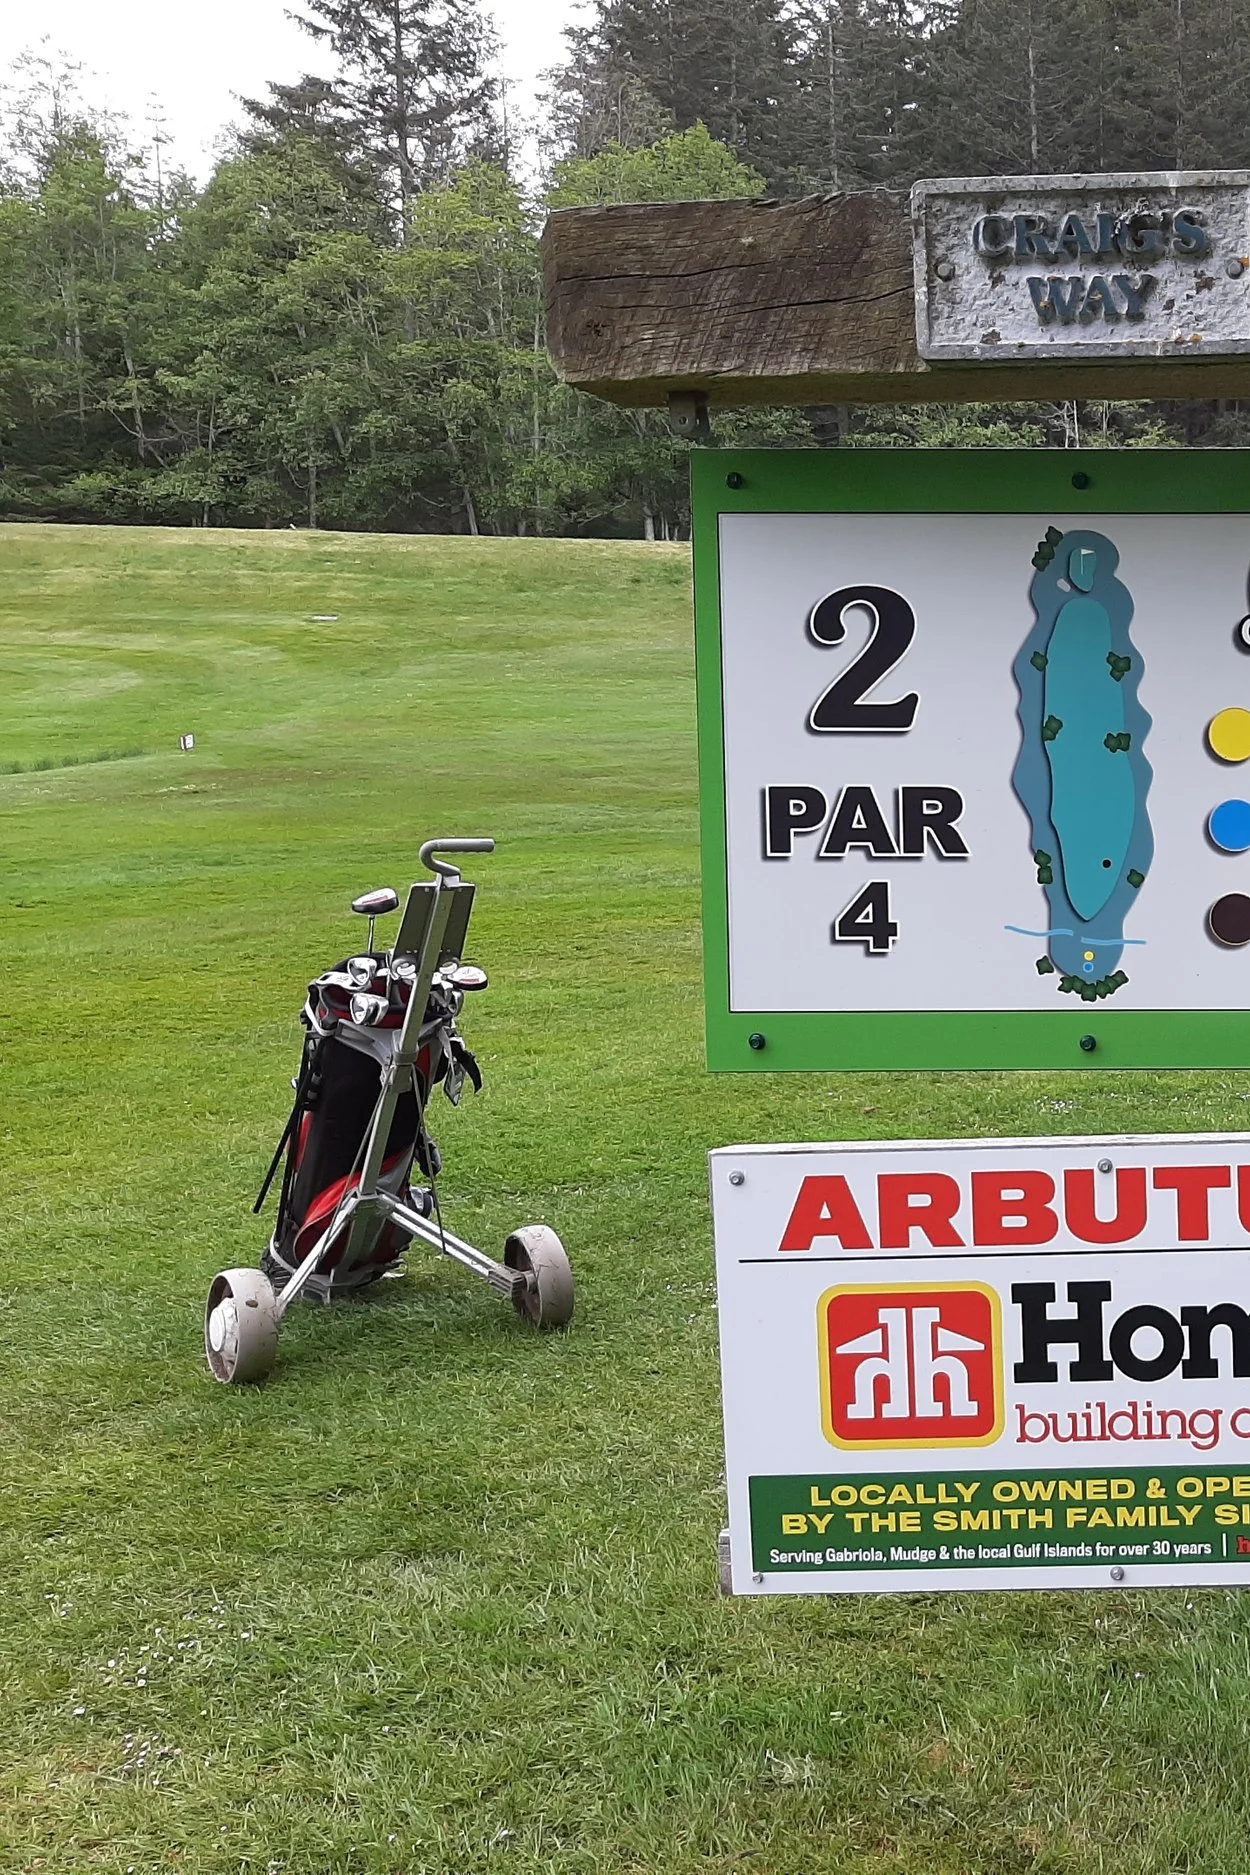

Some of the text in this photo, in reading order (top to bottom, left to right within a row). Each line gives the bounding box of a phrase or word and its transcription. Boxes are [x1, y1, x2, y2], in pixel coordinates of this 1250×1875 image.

[1025, 273, 1156, 324] WAY
[809, 583, 920, 733] 2
[765, 784, 971, 857] PAR
[834, 880, 899, 953] 4
[1015, 1403, 1223, 1450] building
[810, 1482, 980, 1507] LOCALLY
[992, 1478, 1136, 1502] OWNED
[1145, 1478, 1168, 1499] &
[782, 1513, 834, 1535] BY
[846, 1511, 922, 1533] THE
[933, 1508, 1053, 1531] SMITH
[1066, 1504, 1203, 1529] FAMILY
[770, 1541, 1212, 1565] Serving Gabriola, Mudge & the local Gulf Islands for over 30 years
